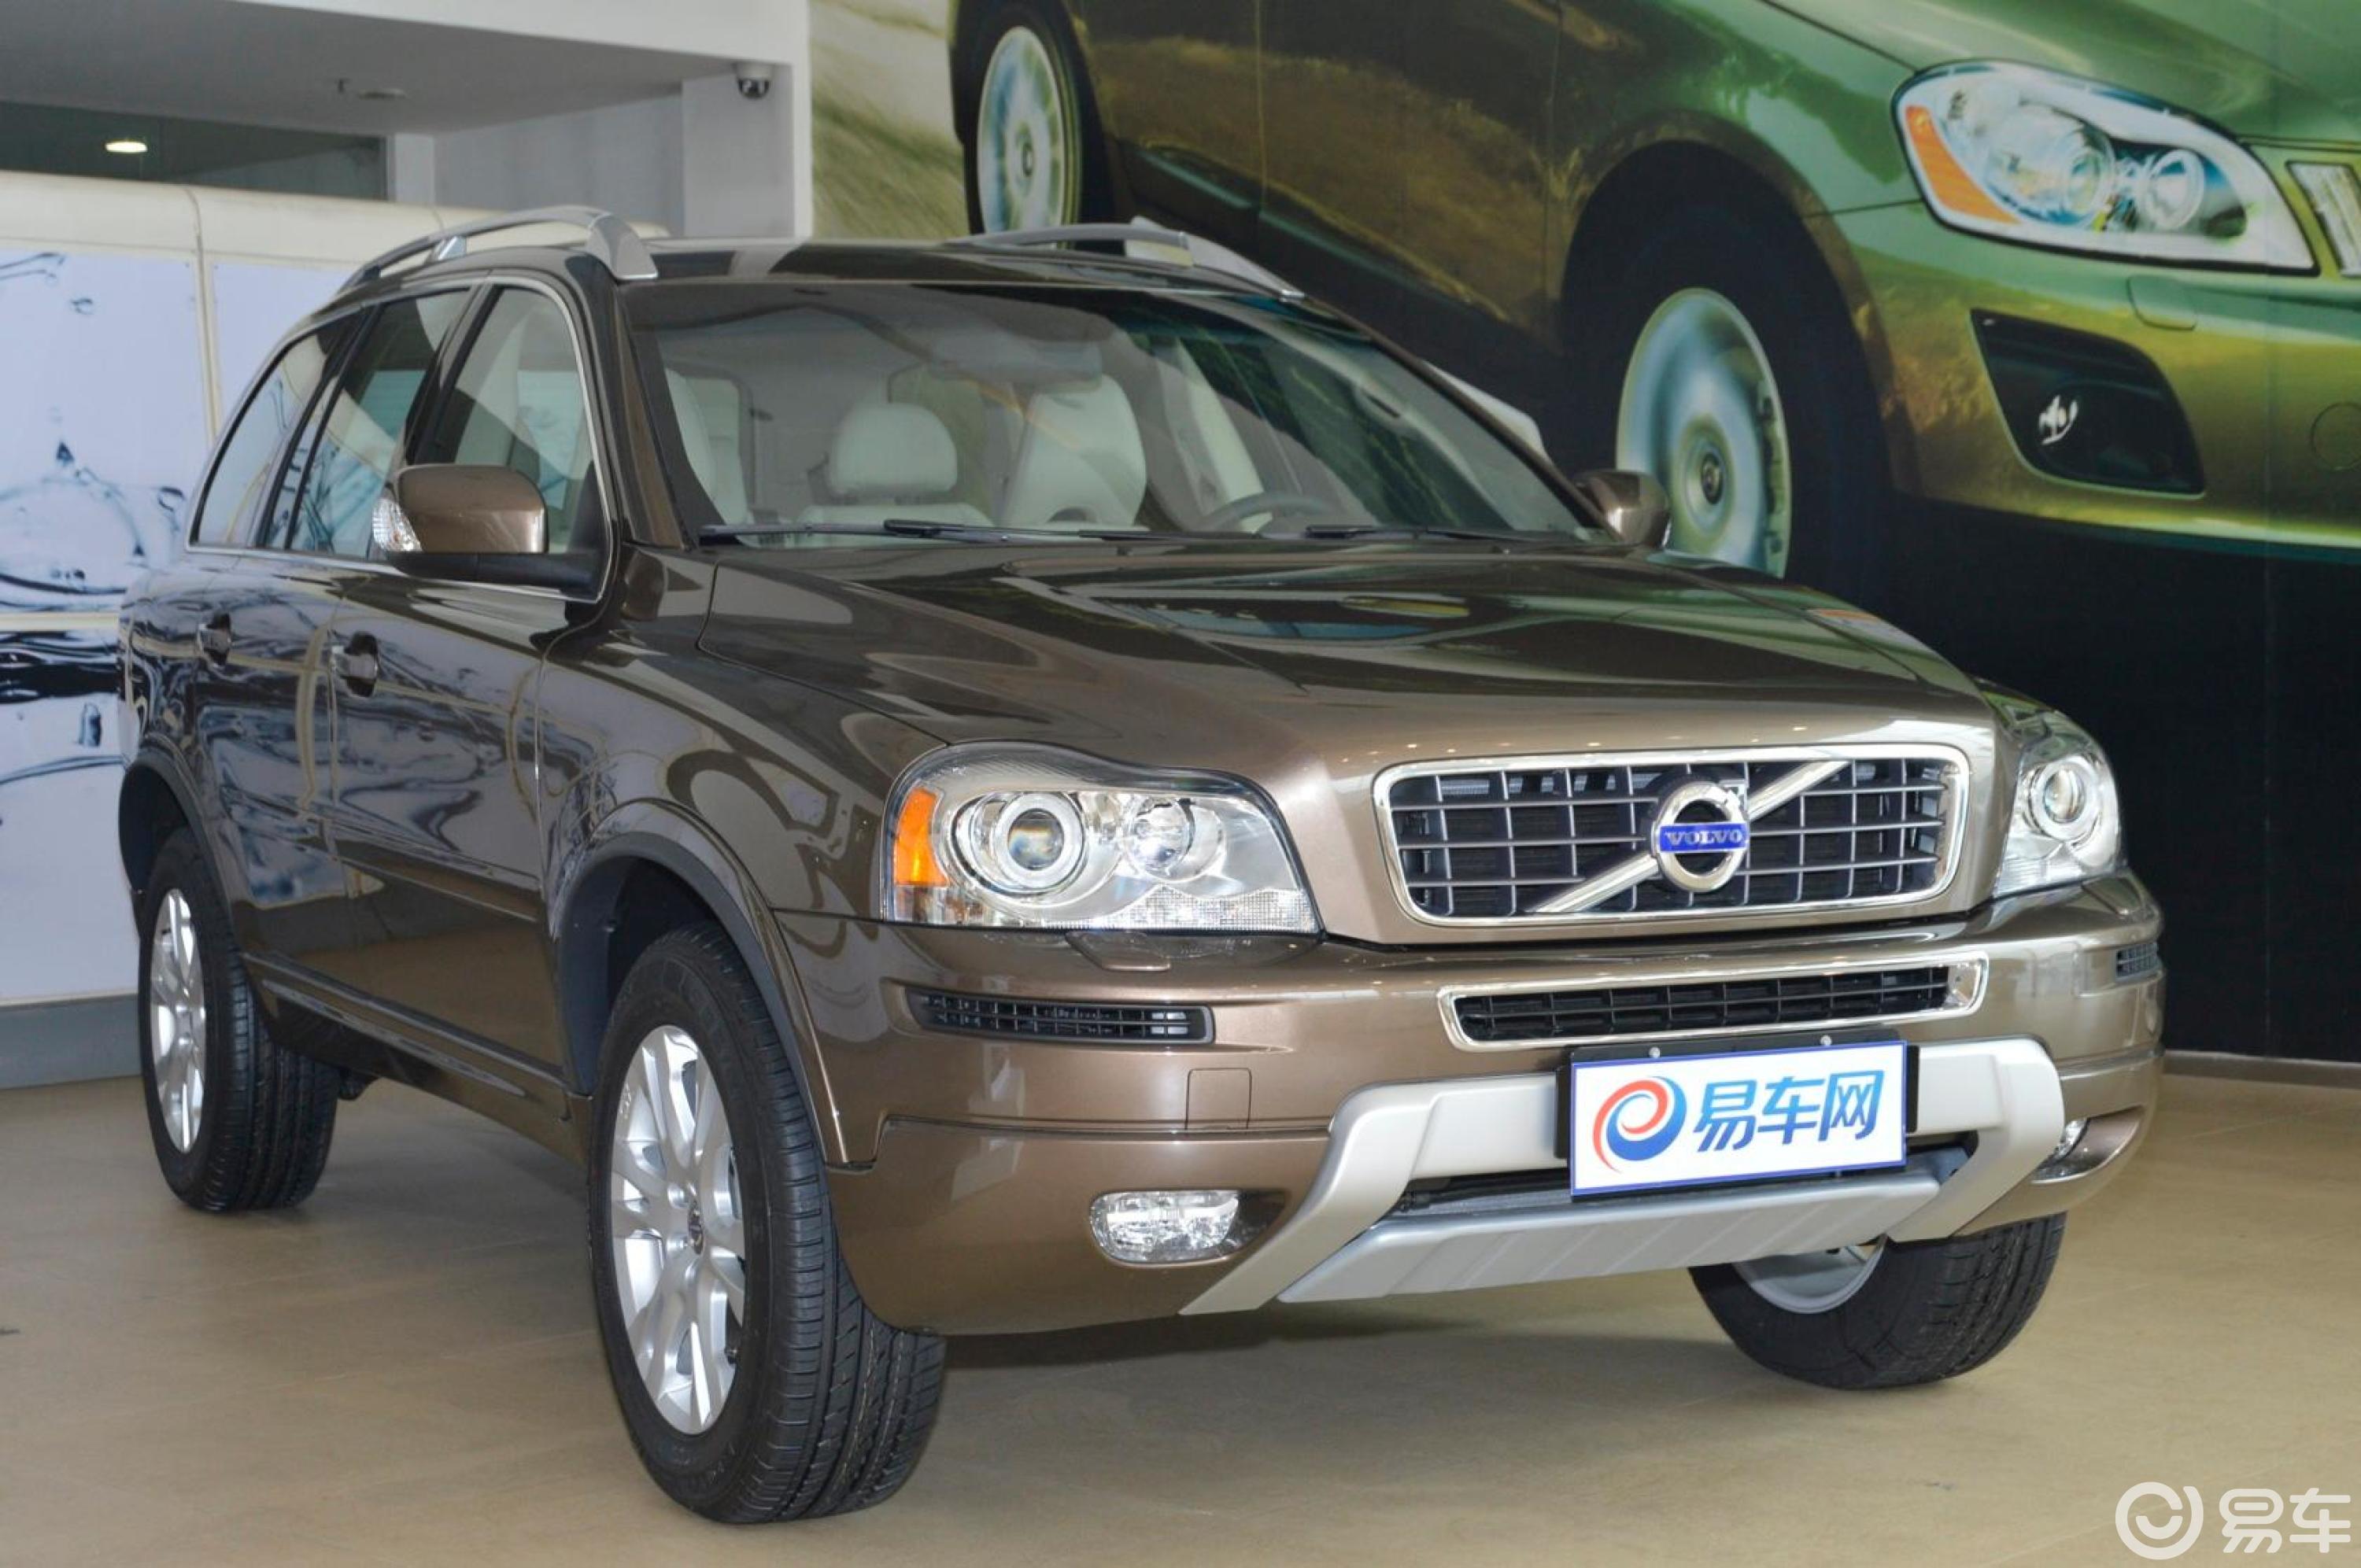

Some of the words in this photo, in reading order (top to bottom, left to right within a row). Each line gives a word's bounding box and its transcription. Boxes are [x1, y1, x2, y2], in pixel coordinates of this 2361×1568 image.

[1665, 828, 1742, 846] VOLVO
[1693, 1069, 1884, 1152] 易车网
